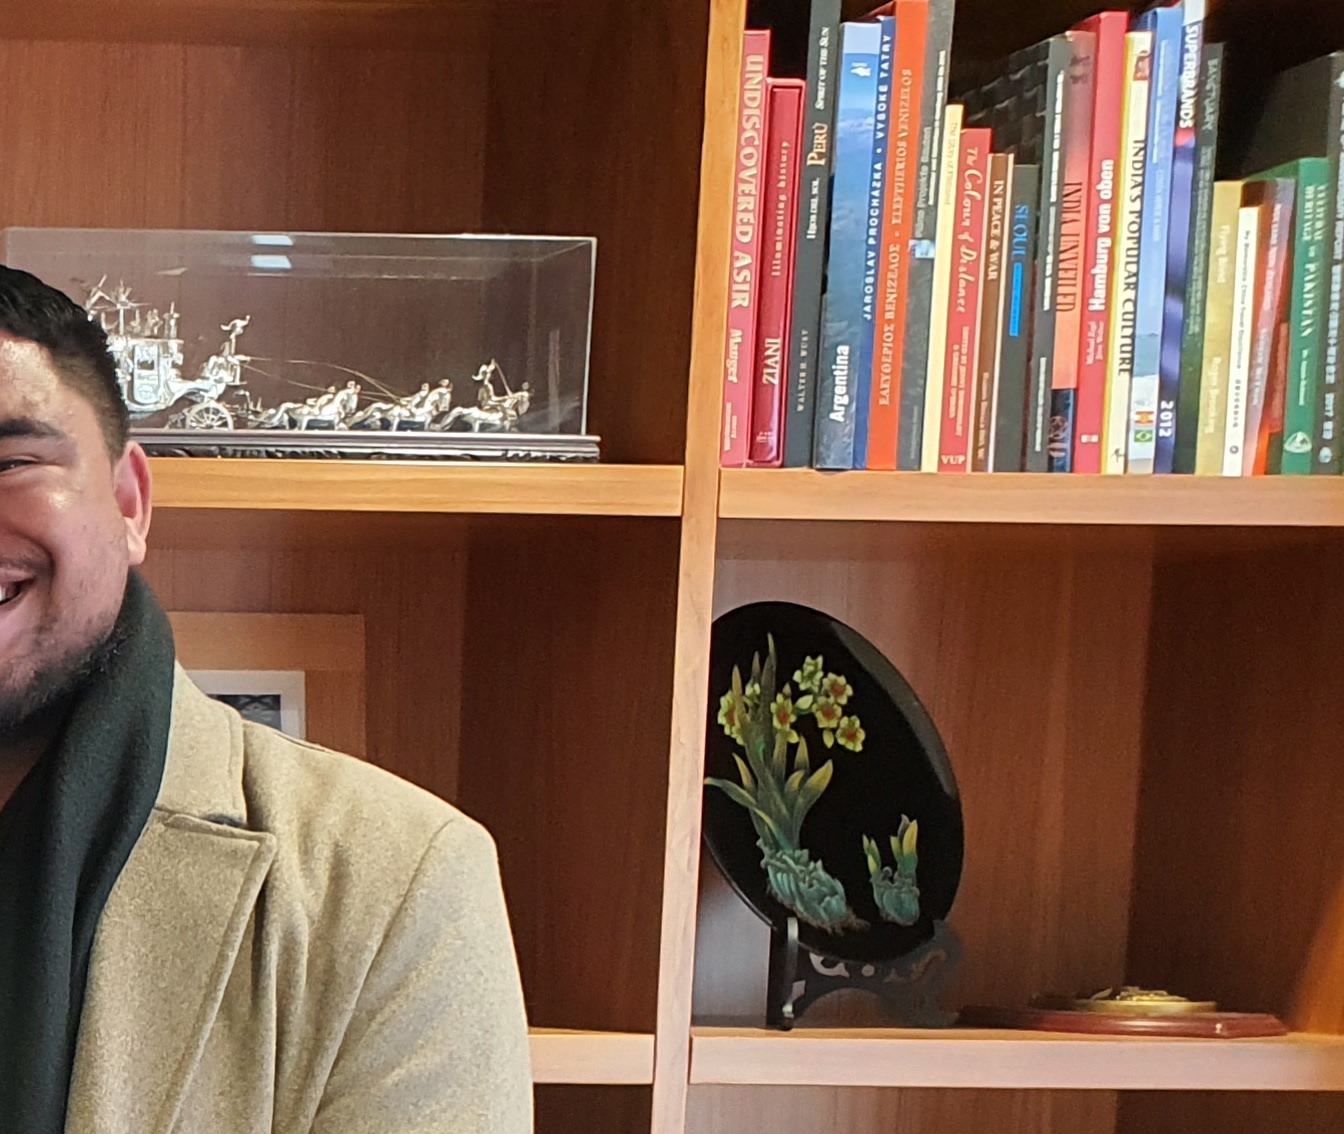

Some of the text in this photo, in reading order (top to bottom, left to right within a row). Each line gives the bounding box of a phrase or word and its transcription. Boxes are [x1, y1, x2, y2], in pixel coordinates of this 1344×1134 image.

[1179, 24, 1199, 129] SUPERBRANDS
[731, 54, 764, 309] UNDISCOVERED ASIR
[863, 250, 876, 321] JAROSLAV
[879, 35, 892, 79] TATRY
[961, 169, 984, 227] Colour
[987, 179, 1005, 281] IN PEACE & WAR
[1012, 204, 1029, 256] SEOUL
[1055, 181, 1084, 313] INDIA UNVEILED
[1087, 159, 1115, 312] Hamburg von oben
[956, 245, 978, 313] Distance
[1301, 263, 1318, 337] PAKISTAN
[762, 338, 782, 386] ZIANI
[1118, 297, 1137, 377] CULTURE
[829, 344, 850, 423] Argentina
[1158, 400, 1174, 438] 2012
[940, 454, 966, 465] VUP
